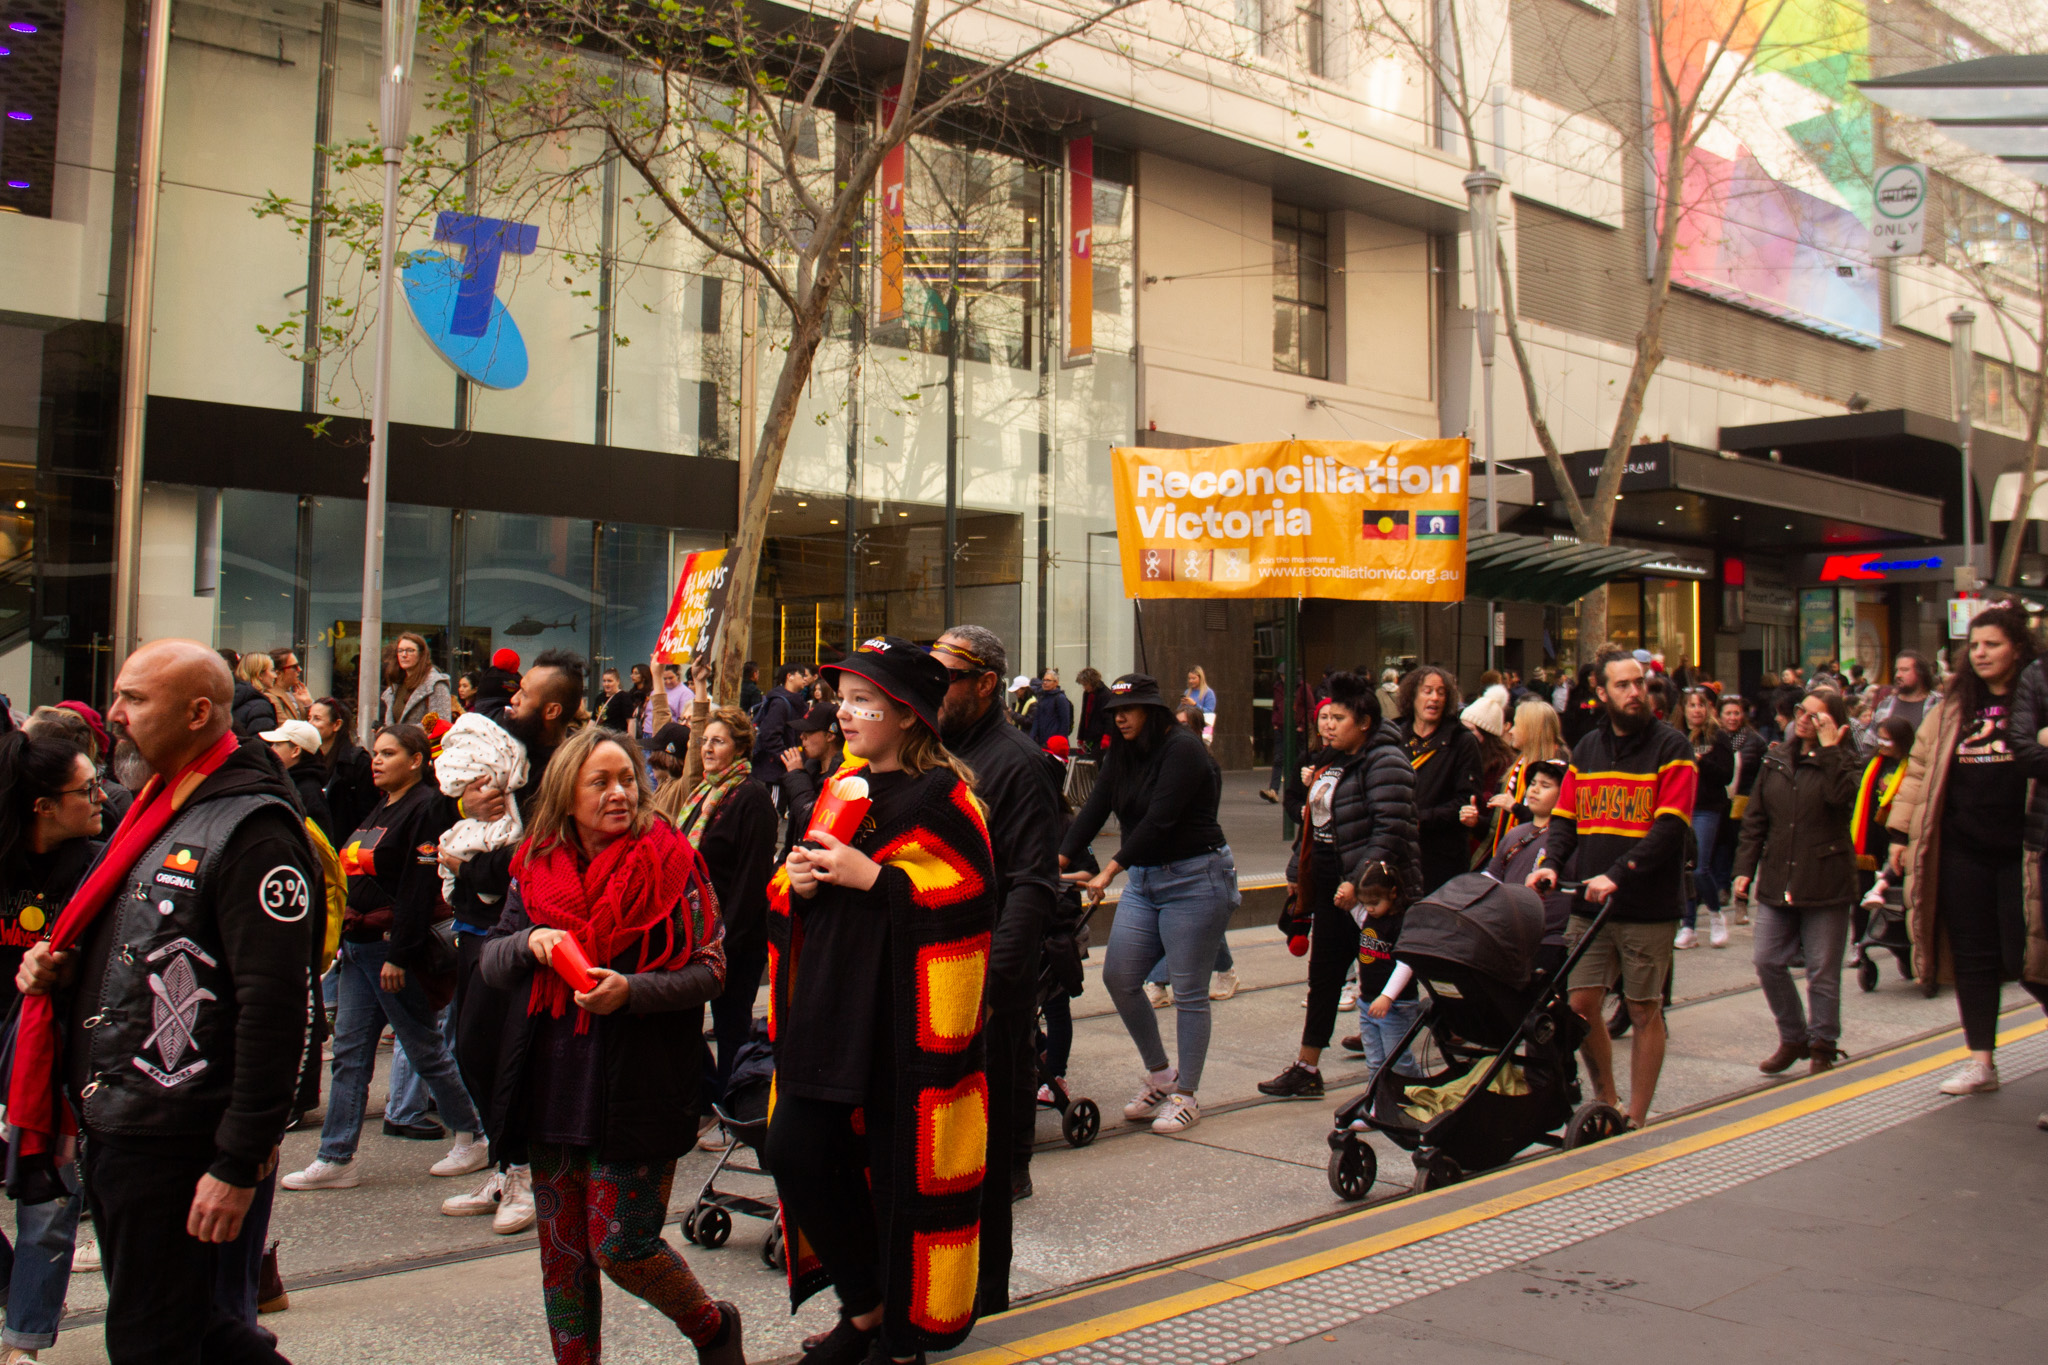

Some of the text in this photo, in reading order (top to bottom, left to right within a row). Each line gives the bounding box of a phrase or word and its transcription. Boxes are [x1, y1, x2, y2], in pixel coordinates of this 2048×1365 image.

[1873, 222, 1918, 237] ONLY
[1137, 454, 1460, 499] Reconciliation
[1135, 498, 1312, 540] Victoria
[1258, 557, 1275, 565] Join
[681, 566, 728, 598] ALWAYS
[1258, 566, 1459, 585] www.reconciliationvic.org.au
[670, 608, 715, 632] ALWAYS
[695, 625, 710, 653] be
[155, 872, 197, 890] ORIGINAL
[266, 879, 307, 908] 3%
[147, 1066, 194, 1084] WARRIORS
